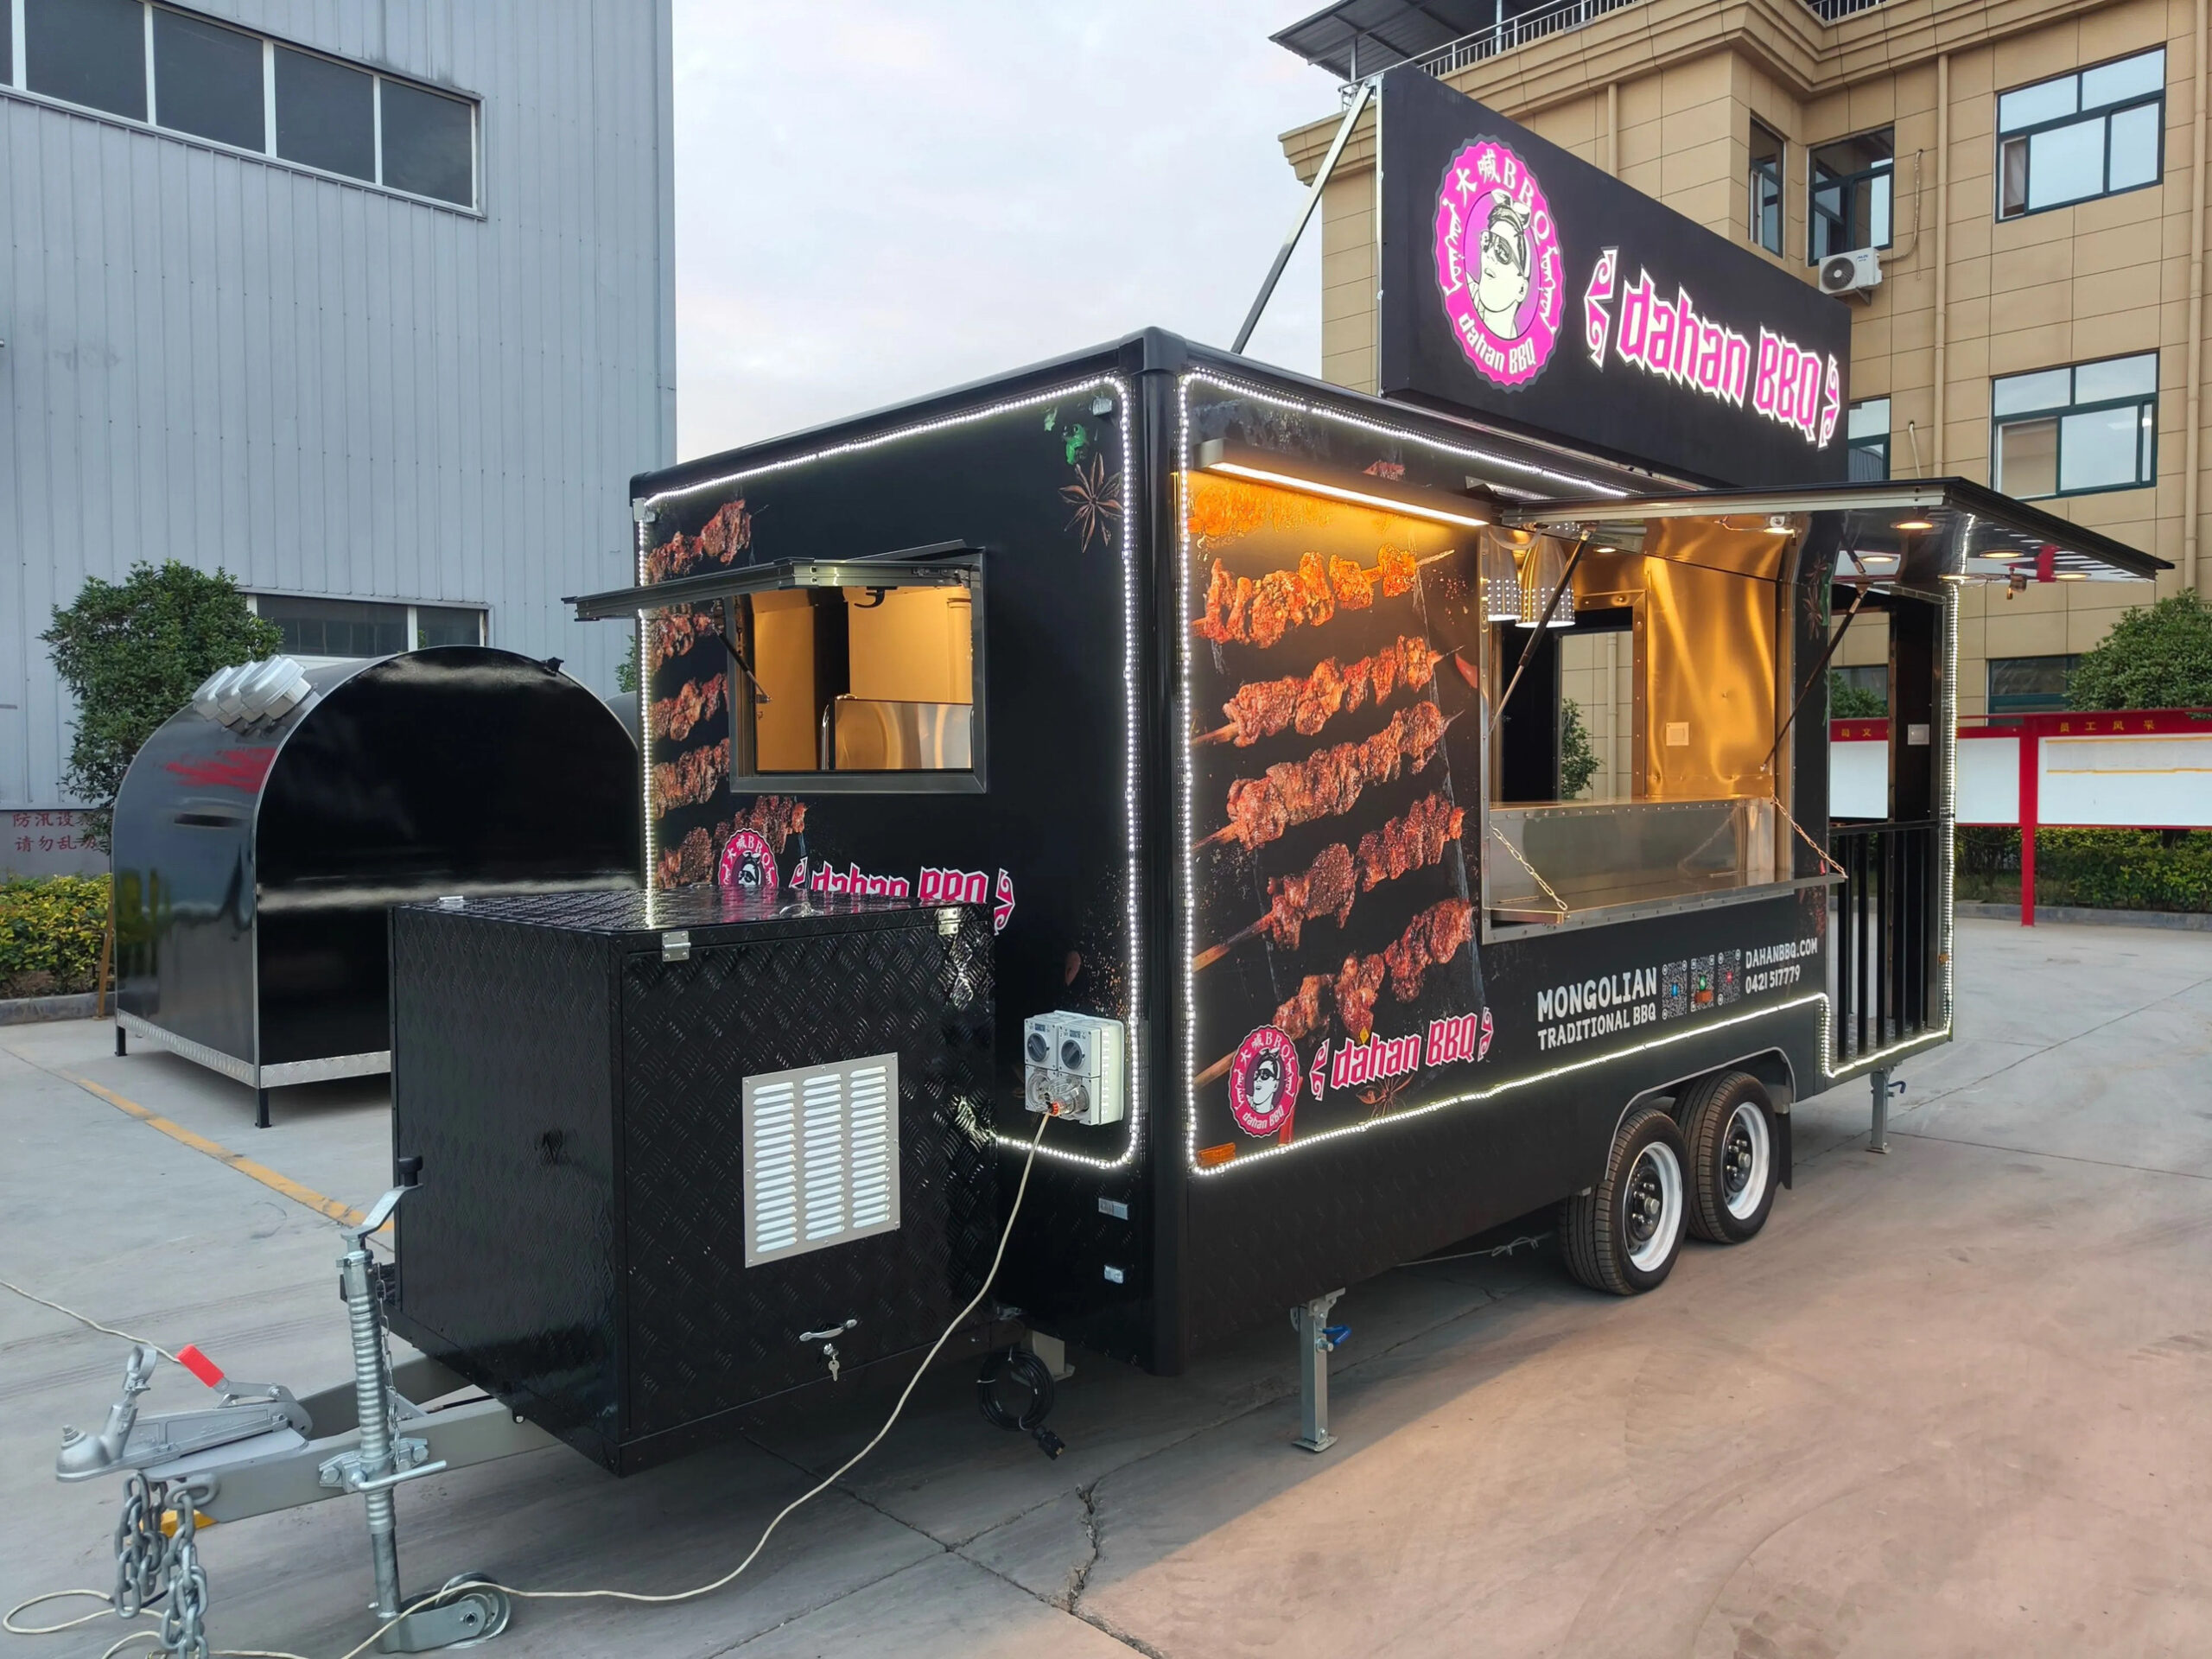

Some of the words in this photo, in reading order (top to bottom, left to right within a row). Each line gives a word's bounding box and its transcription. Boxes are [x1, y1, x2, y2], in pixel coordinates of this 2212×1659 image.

[1458, 313, 1505, 373] dahan
[1509, 337, 1536, 375] BBQ
[1617, 265, 1751, 410] dahan
[1753, 325, 1822, 442] BBQ
[13, 812, 93, 828] 防汛设
[1745, 937, 1818, 969] DAHANBBQ.COM
[1537, 966, 1657, 1022] MONGOLIAN
[1745, 972, 1768, 994] 0421
[1770, 964, 1801, 988] 517779
[1330, 1032, 1422, 1090] dahan
[1425, 1012, 1478, 1068] BBQ
[1537, 1008, 1630, 1051] TRADITIONAL
[1632, 1002, 1656, 1026] BBQ
[1243, 1112, 1268, 1129] dahan
[1269, 1105, 1285, 1127] BBQ
